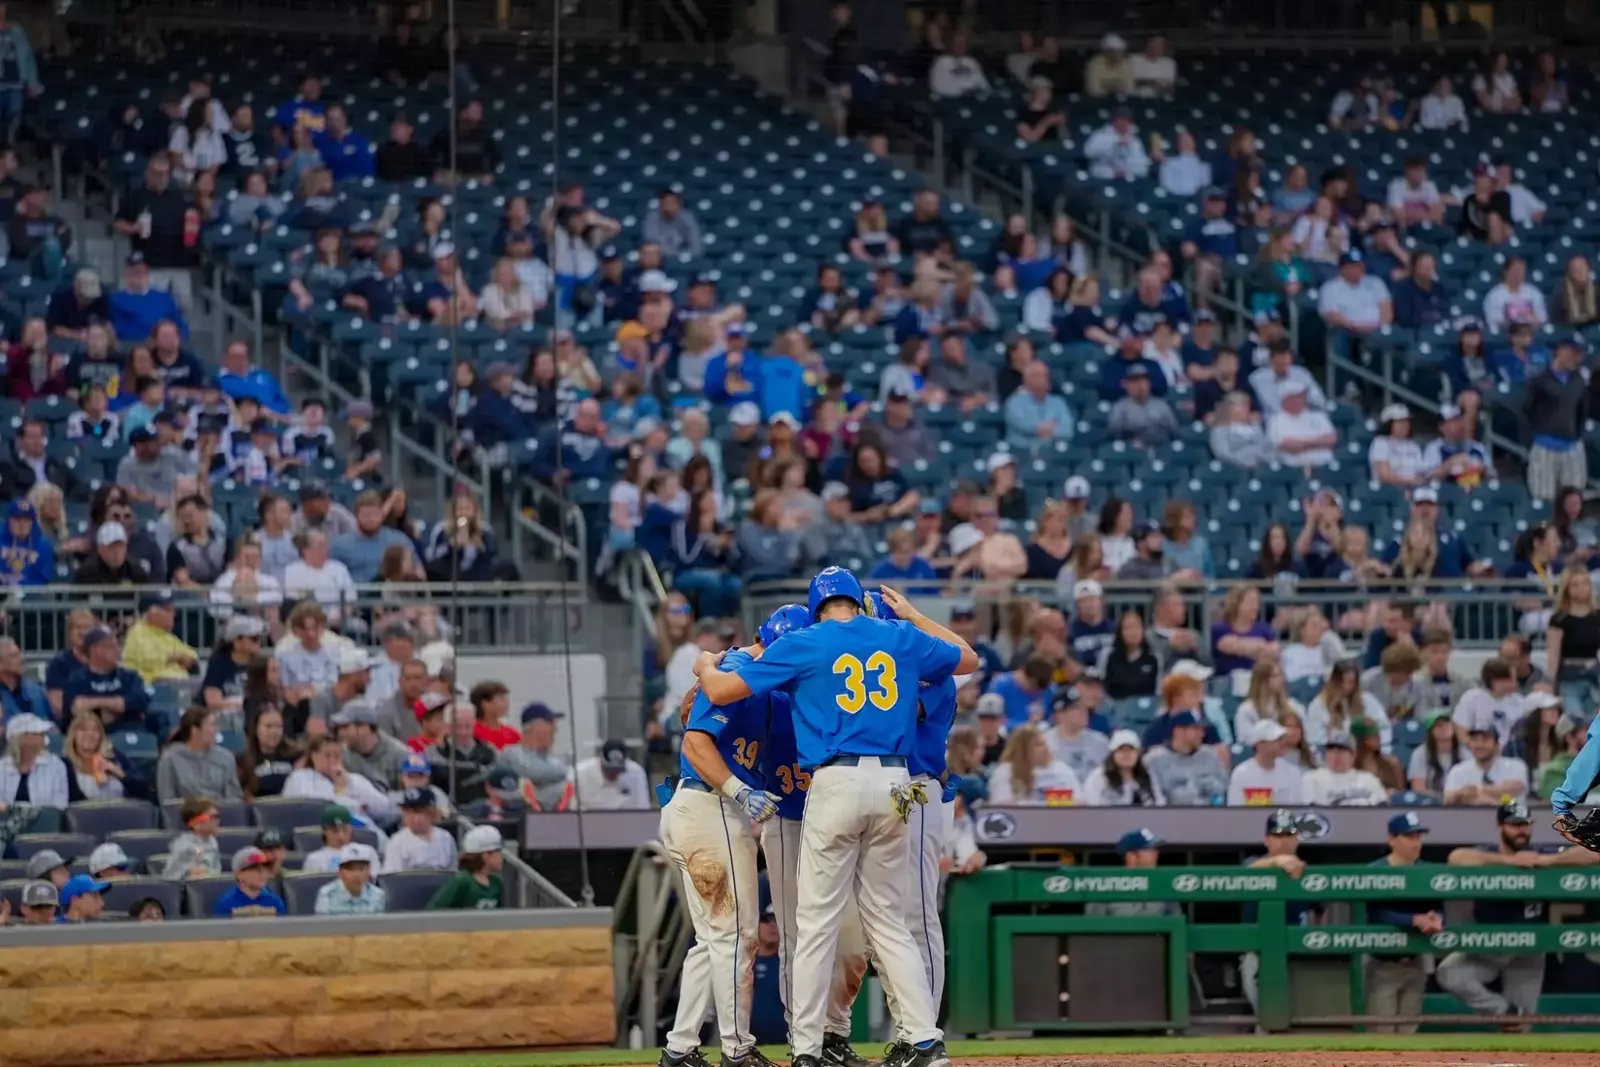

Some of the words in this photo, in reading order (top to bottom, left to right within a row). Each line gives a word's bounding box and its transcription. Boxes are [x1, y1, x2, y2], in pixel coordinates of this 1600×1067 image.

[832, 650, 899, 714] 33
[732, 737, 759, 770] 39
[776, 763, 811, 795] 35
[1074, 876, 1149, 891] HYUNDAI
[1203, 875, 1278, 890] HYUNDAI
[1331, 875, 1406, 890] HYUNDAI
[1461, 874, 1536, 890] HYUNDAI
[1333, 932, 1408, 948] HYUNDAI
[1461, 931, 1536, 948] HYUNDAI
